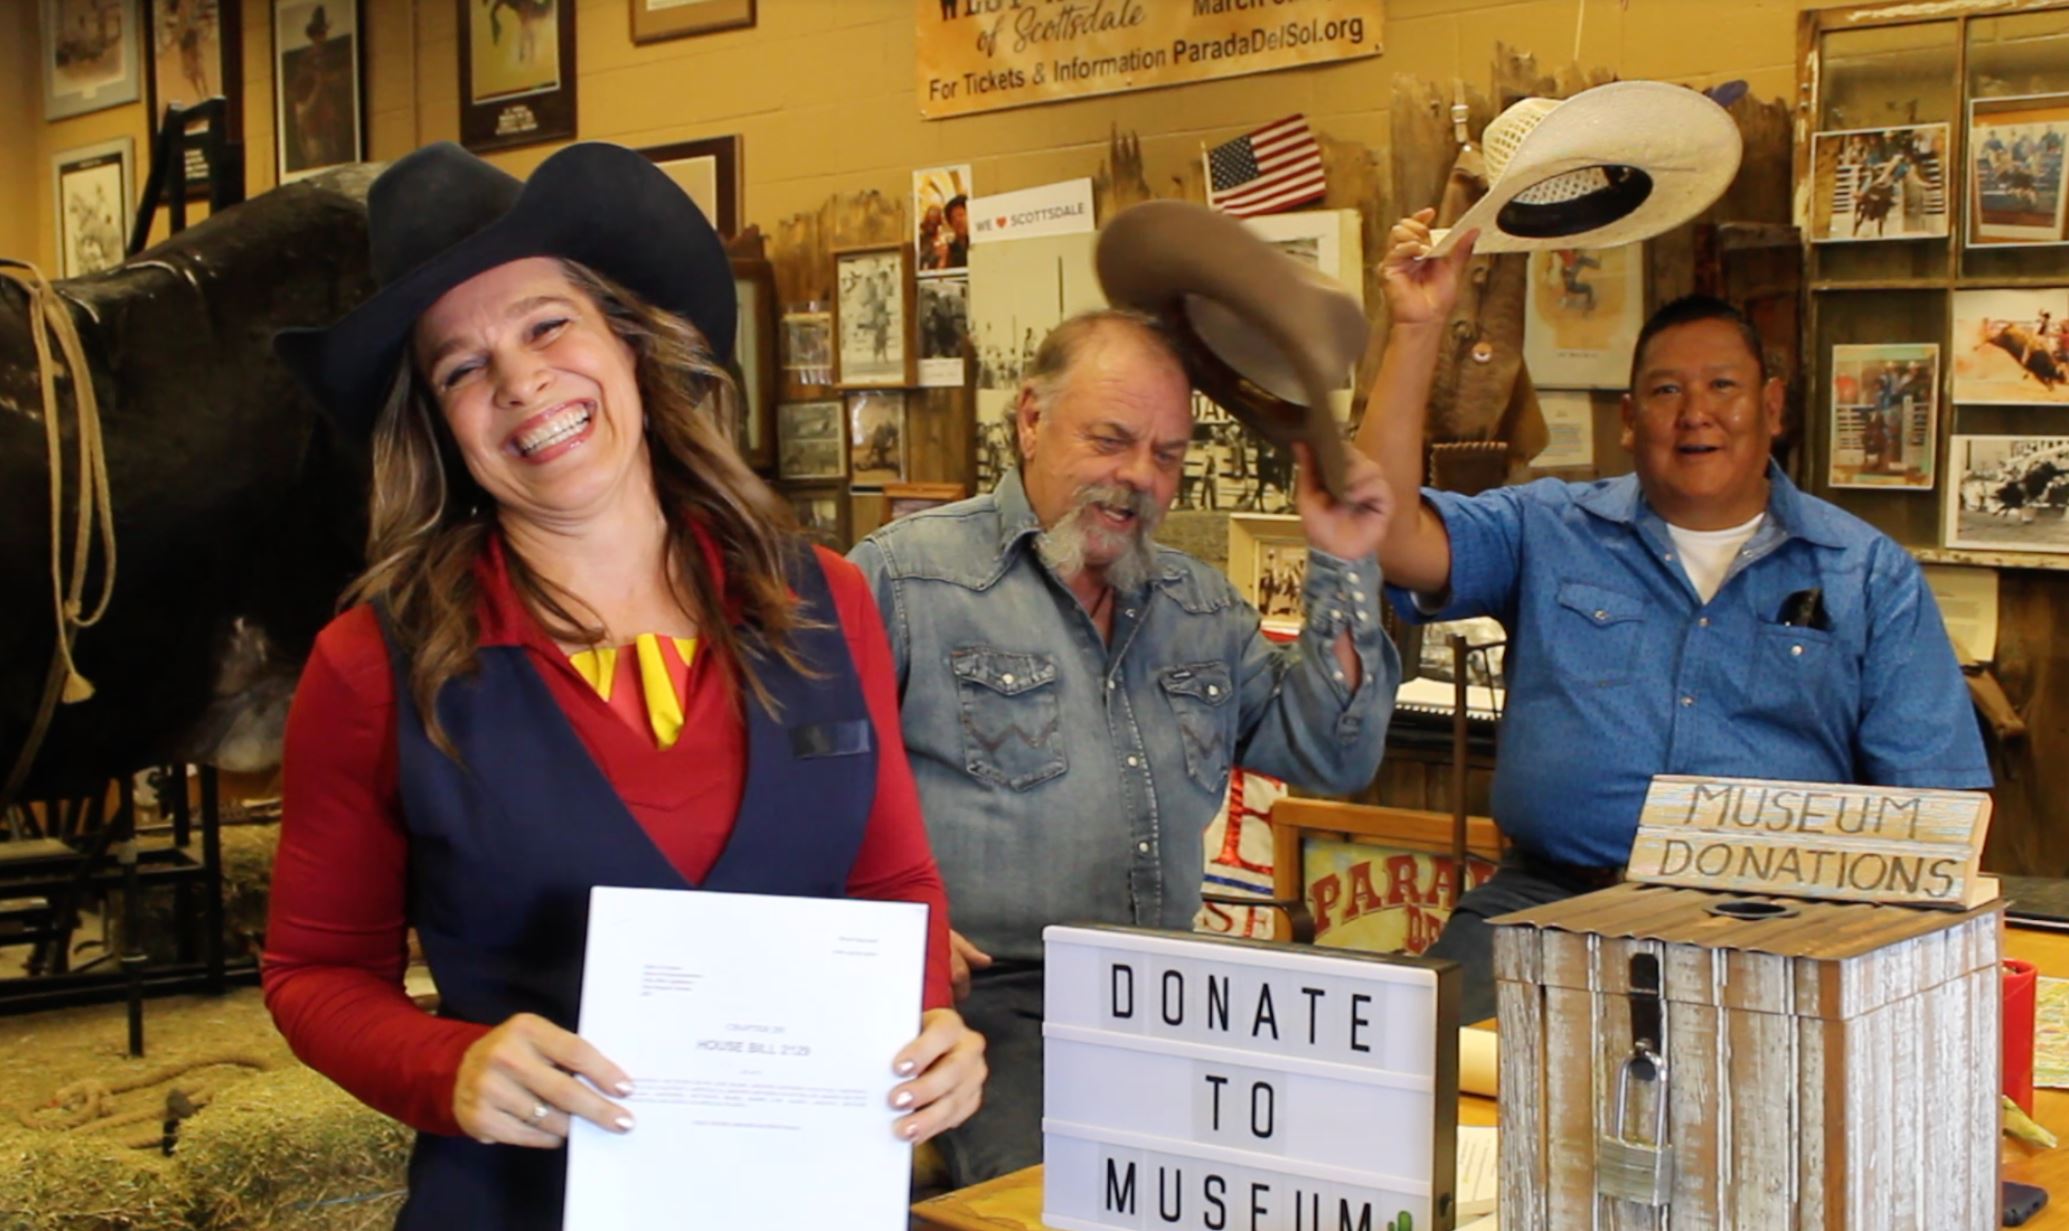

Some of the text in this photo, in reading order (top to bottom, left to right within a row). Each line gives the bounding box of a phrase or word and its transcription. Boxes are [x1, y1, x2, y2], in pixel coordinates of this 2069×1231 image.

[929, 17, 1364, 100] For Tickets & Information ParadaDelSol.org
[975, 0, 1146, 58] of Scottsdale
[976, 202, 1085, 232] WE SCOTTSDALE
[1683, 783, 1922, 839] MUSEUM
[1658, 838, 1958, 898] DONATIONS
[1111, 964, 1372, 1053] DONATE
[696, 1039, 744, 1053] HOUSE
[747, 1041, 777, 1055] BILL
[1205, 1074, 1274, 1139] TO
[1106, 1158, 1371, 1231] MUSEUM
